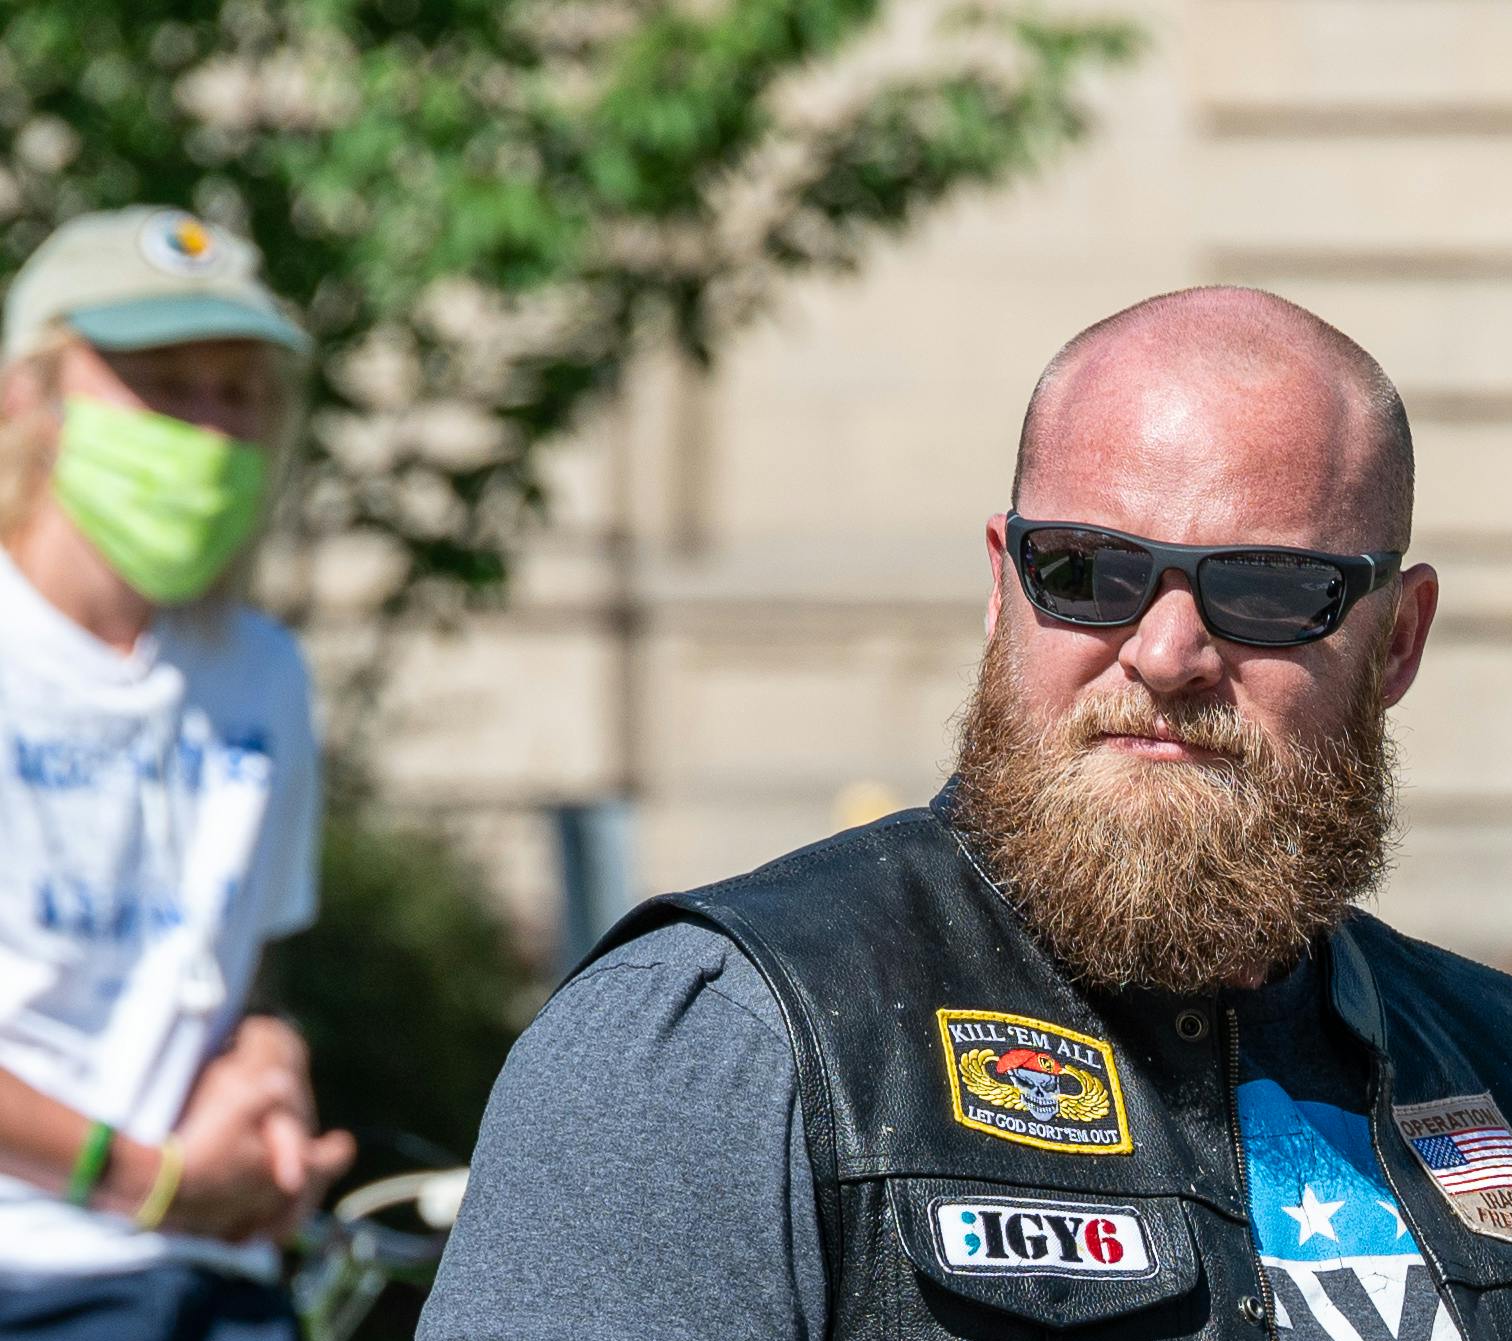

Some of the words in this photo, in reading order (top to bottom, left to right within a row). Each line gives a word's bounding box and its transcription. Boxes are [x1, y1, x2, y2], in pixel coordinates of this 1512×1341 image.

[948, 1023, 1006, 1043] KILL
[1057, 1039, 1102, 1069] ALL
[968, 1105, 995, 1124] LET
[995, 1113, 1027, 1134] GOD
[1027, 1121, 1063, 1141] SORT
[1089, 1129, 1119, 1145] OUT
[1400, 1108, 1499, 1138] OPERATION
